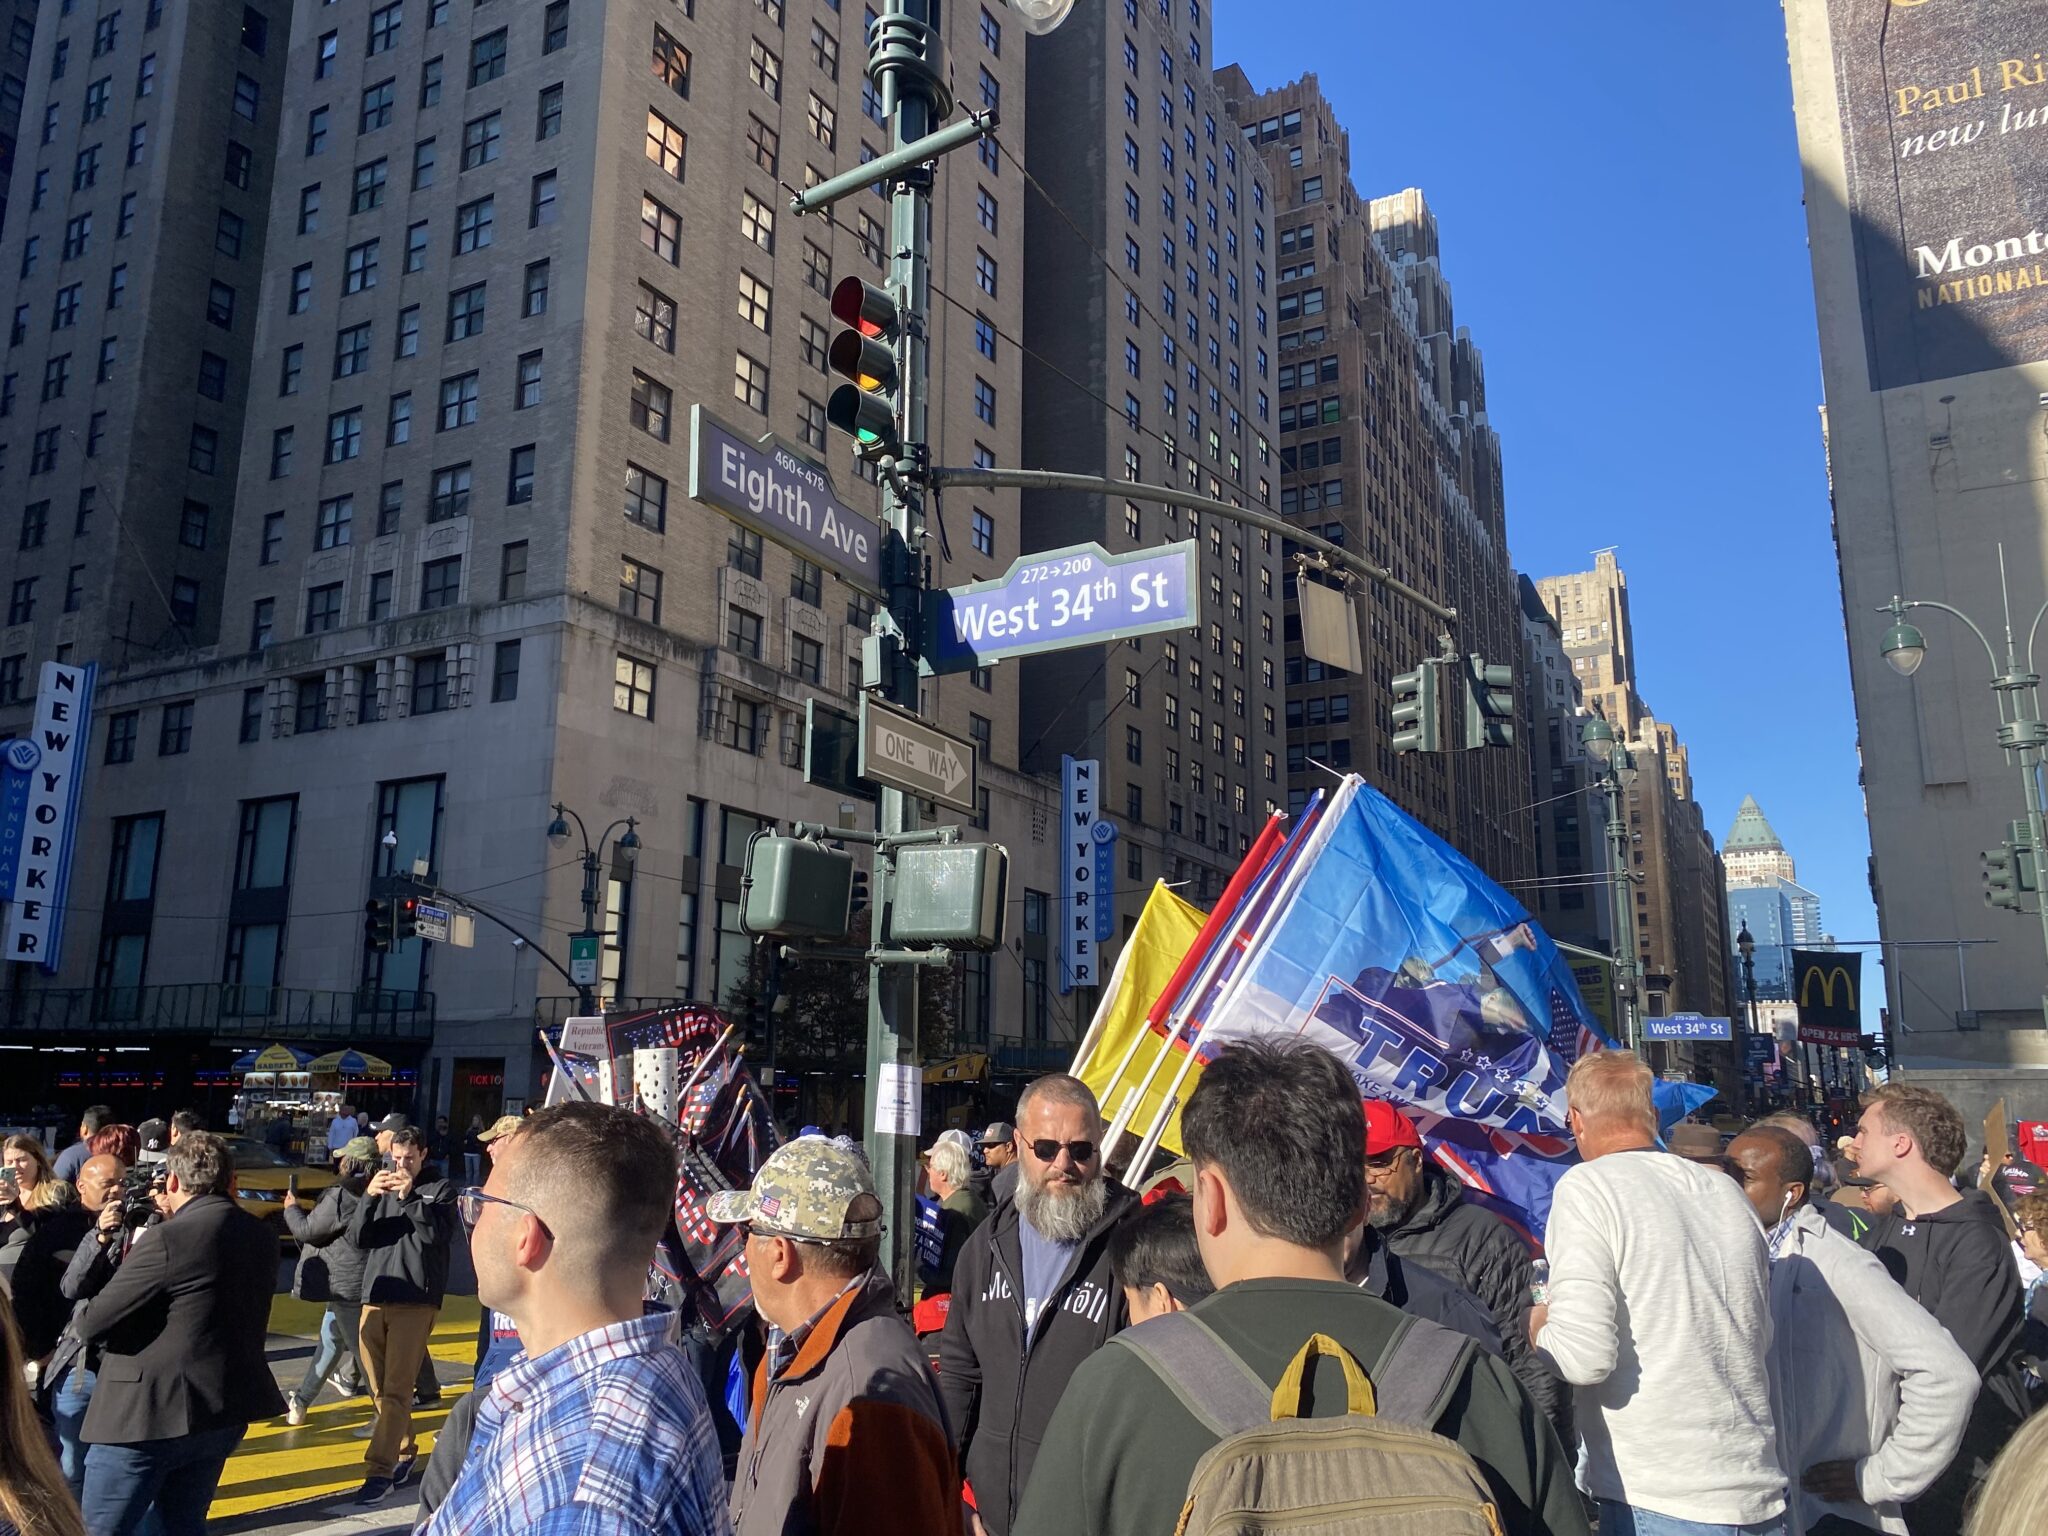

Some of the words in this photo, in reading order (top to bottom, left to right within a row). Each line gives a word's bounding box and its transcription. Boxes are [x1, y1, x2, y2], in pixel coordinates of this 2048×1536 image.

[1895, 67, 1986, 117] Paul
[1997, 53, 2048, 92] Ri
[1900, 120, 1985, 158] new
[1913, 229, 2048, 279] Mont
[1918, 265, 2048, 309] NATIONAL
[774, 450, 796, 474] 460
[805, 470, 826, 492] 478
[721, 442, 813, 532] Eighth
[820, 506, 868, 564] Ave
[1021, 567, 1049, 585] 272
[1062, 557, 1092, 576] 200
[953, 599, 1040, 644] West
[1051, 577, 1117, 627] 34th
[1130, 571, 1169, 613] St
[44, 671, 75, 752] NEW
[885, 732, 915, 766] ONE
[928, 749, 958, 781] WAY
[1074, 766, 1091, 826] NEW
[0, 778, 25, 890] WYNDHAM
[17, 772, 61, 954] YORKER
[1075, 842, 1090, 980] YORKER
[1098, 849, 1108, 934] WYNDHAM
[1650, 1023, 1682, 1035] West
[1685, 1022, 1707, 1035] 34th
[1710, 1023, 1724, 1035] St
[1801, 1027, 1825, 1040] OPEN
[1827, 1030, 1839, 1041] 24
[1840, 1031, 1859, 1042] HRS
[1351, 1070, 1382, 1094] AKE
[648, 1264, 673, 1296] ACK
